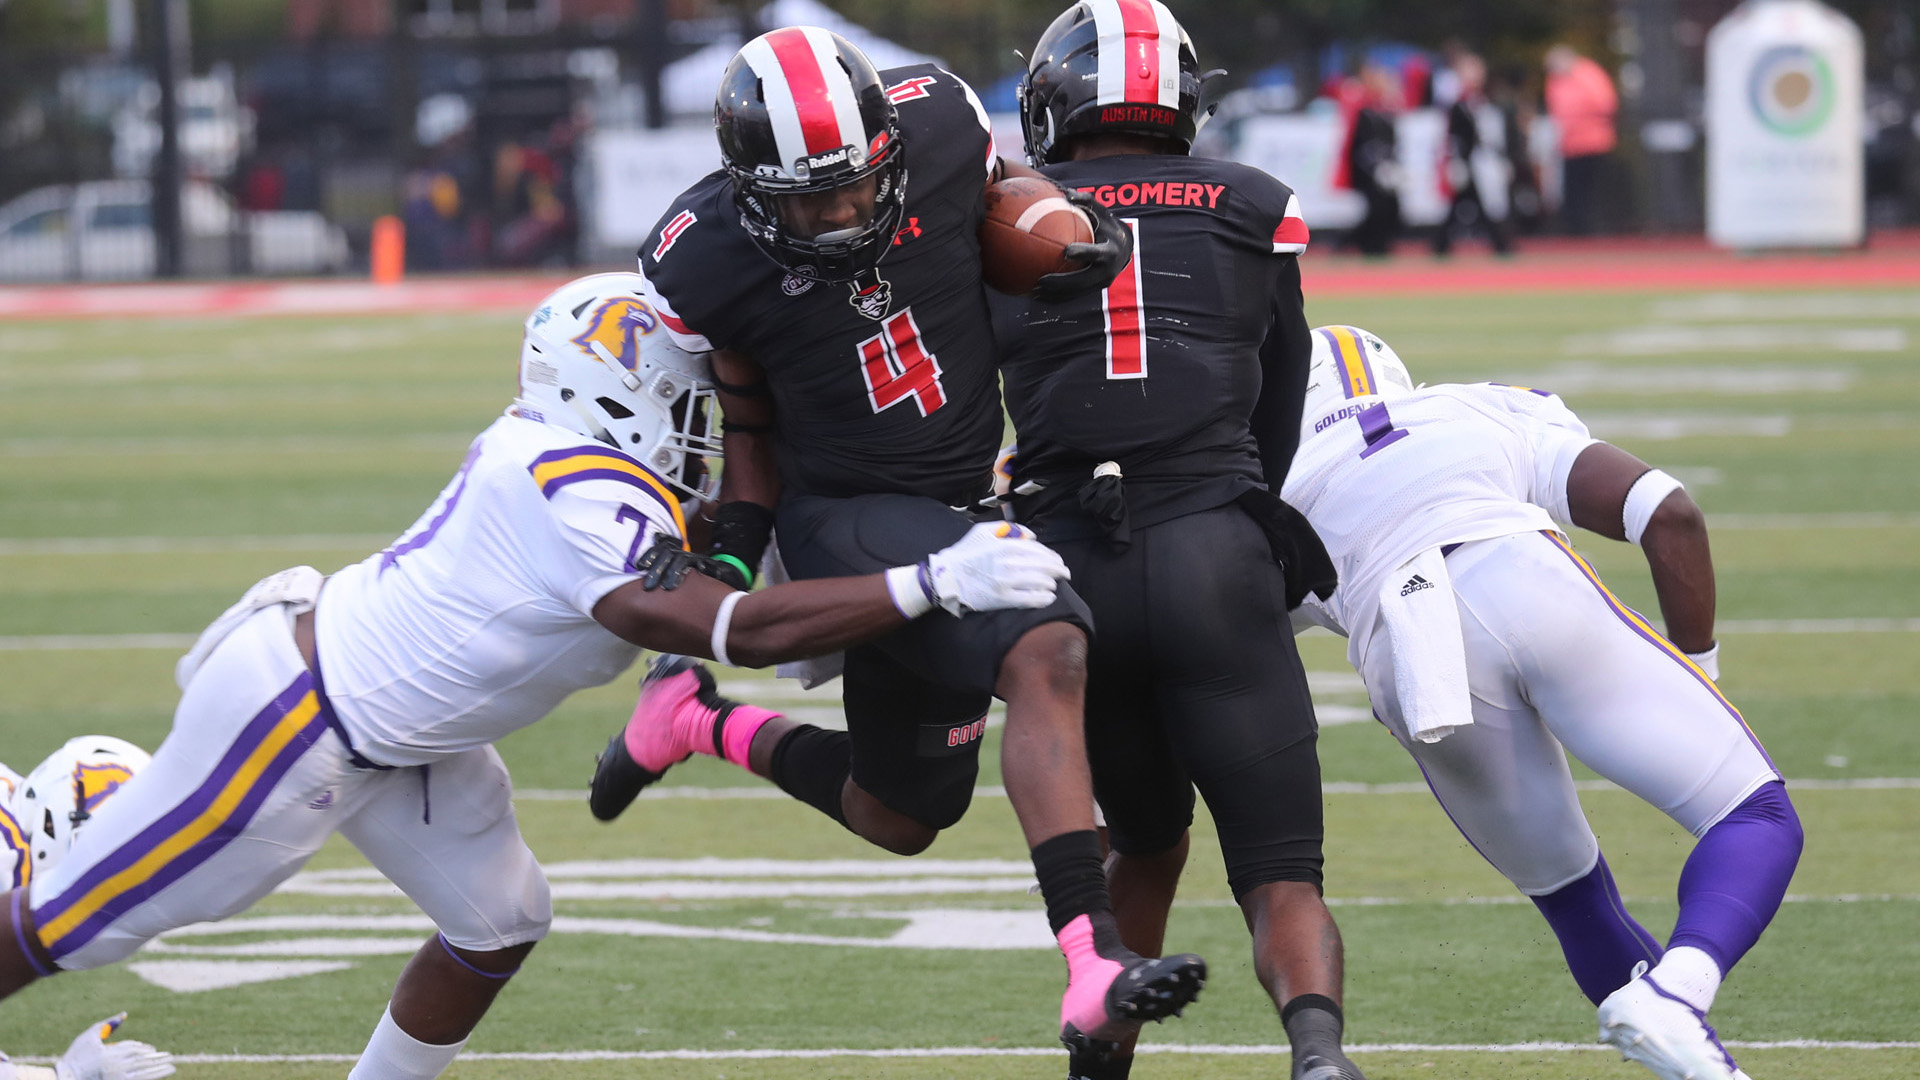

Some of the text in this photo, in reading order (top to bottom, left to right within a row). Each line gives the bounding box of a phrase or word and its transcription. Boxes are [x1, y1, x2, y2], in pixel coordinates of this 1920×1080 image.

[885, 75, 938, 105] 4
[1101, 106, 1177, 127] AUSTIN PEAY
[808, 149, 847, 169] Riddell
[652, 209, 698, 263] 4
[1101, 217, 1148, 379] 1
[856, 305, 947, 418] 4
[1355, 377, 1365, 393] 1
[1359, 401, 1410, 460] 1
[615, 502, 650, 574] 7
[1400, 582, 1434, 597] adidas
